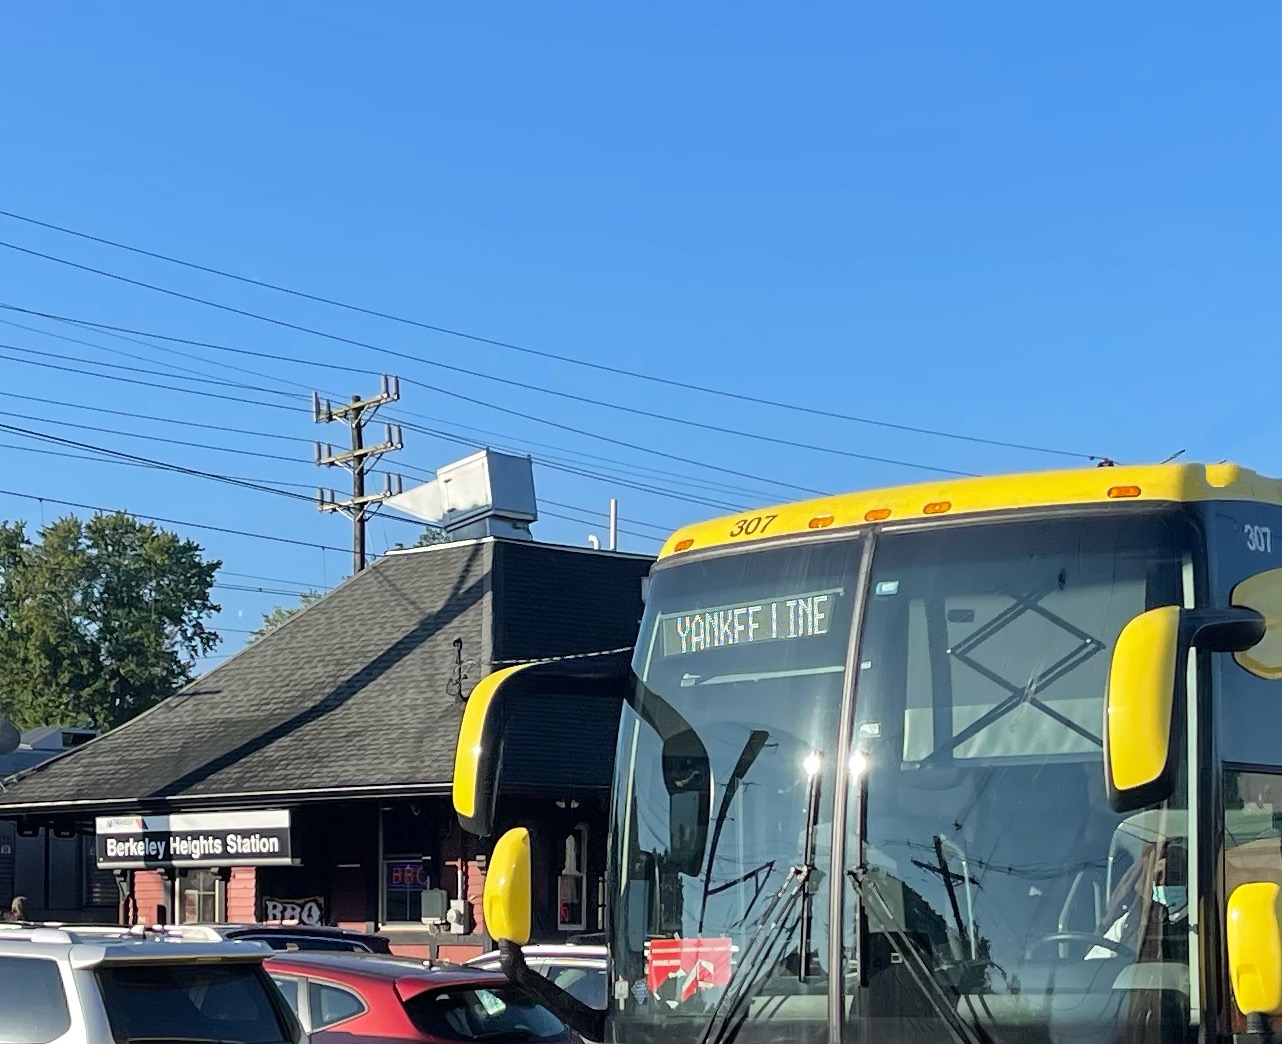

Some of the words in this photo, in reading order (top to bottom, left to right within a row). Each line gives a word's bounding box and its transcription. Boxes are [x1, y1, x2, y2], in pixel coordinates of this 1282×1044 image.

[729, 514, 779, 538] 307
[1244, 523, 1272, 553] 307
[106, 837, 166, 860] Berkeley
[169, 834, 223, 860] Heights
[226, 833, 279, 854] Station
[265, 900, 322, 926] BBQ
